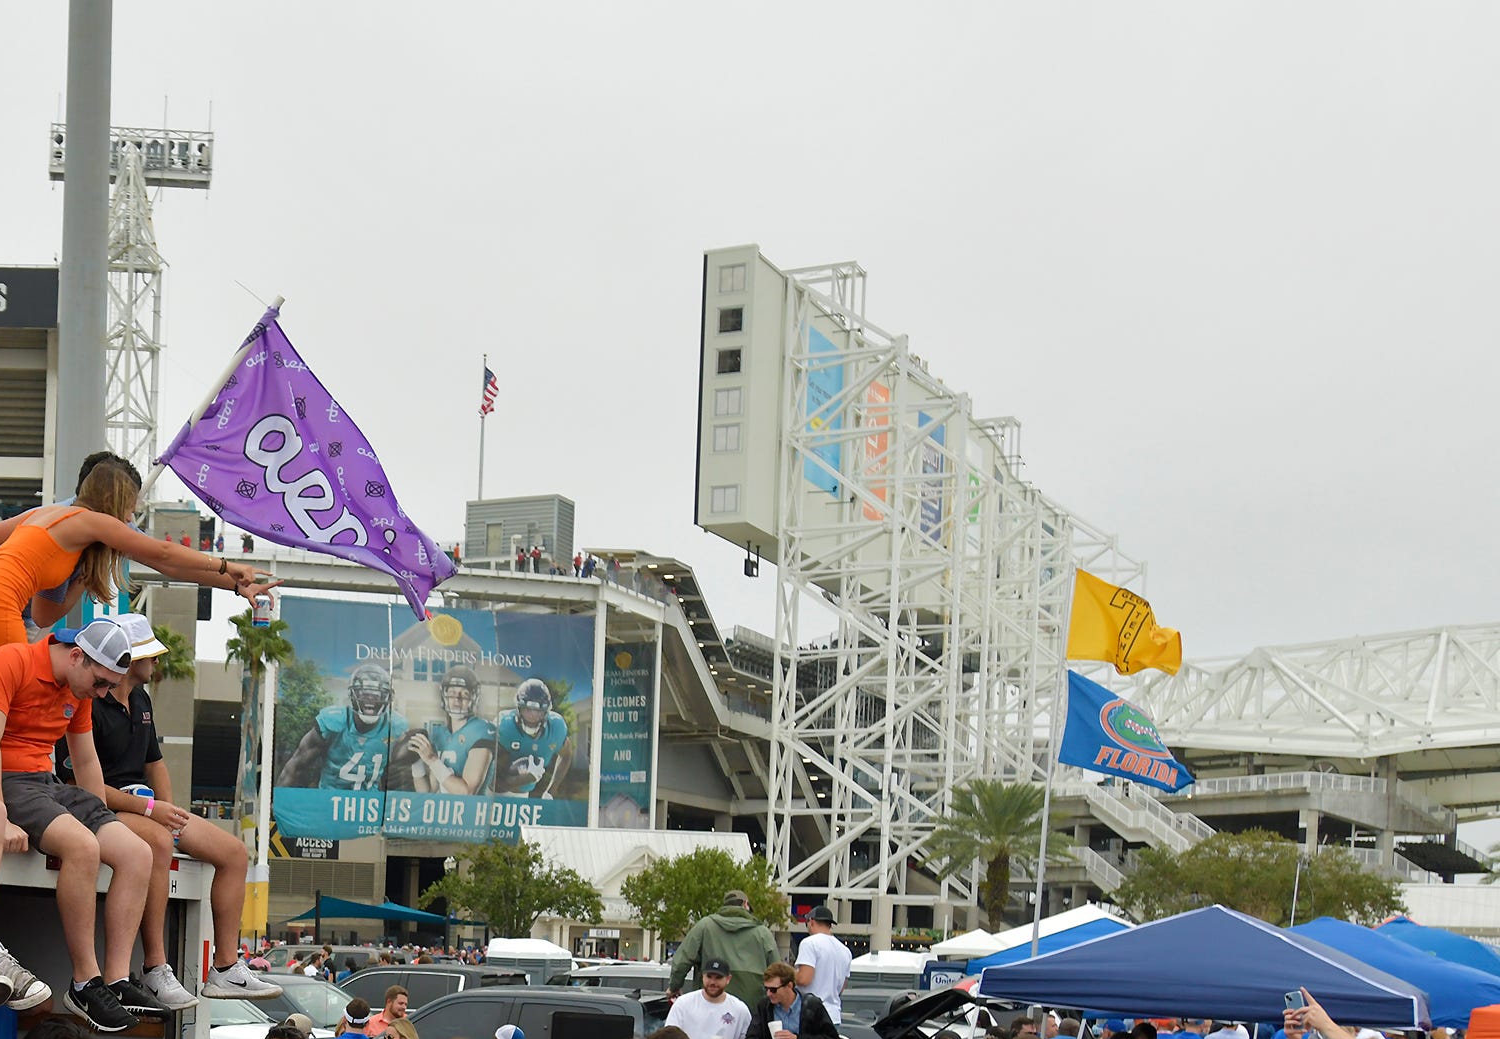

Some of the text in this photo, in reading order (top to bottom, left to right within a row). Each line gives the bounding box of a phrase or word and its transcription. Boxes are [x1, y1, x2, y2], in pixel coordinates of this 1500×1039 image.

[606, 710, 639, 723] YOU TO
[613, 749, 632, 761] AND
[1093, 745, 1179, 788] FLORIDA
[330, 796, 544, 828] THIS IS OUR HOUSE
